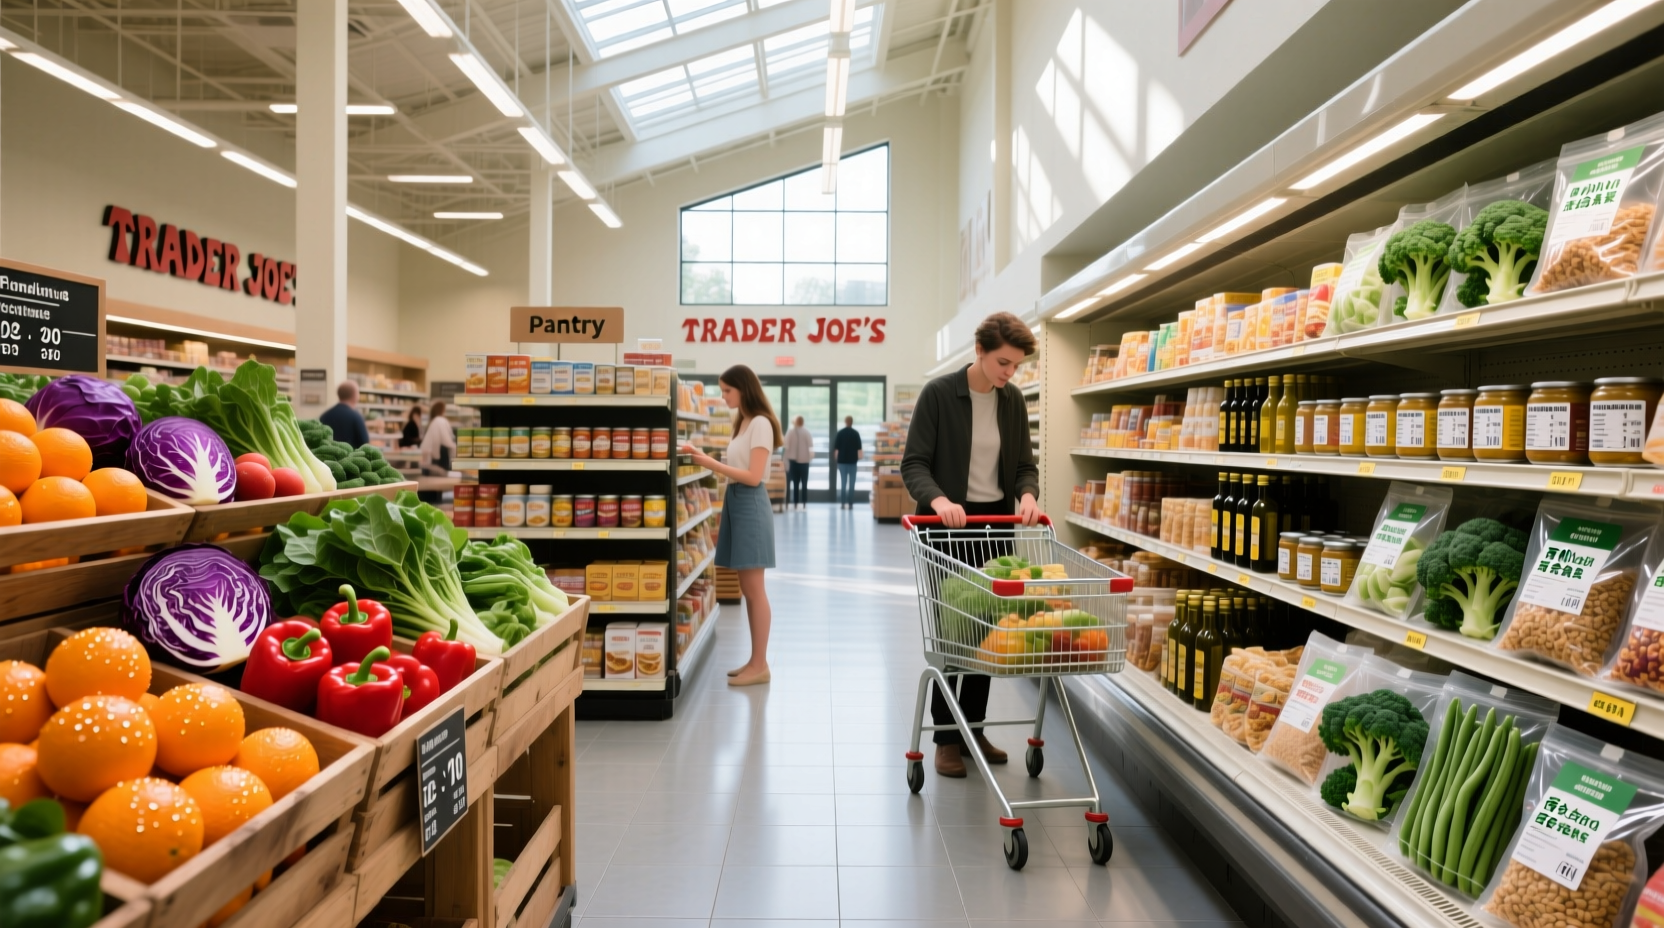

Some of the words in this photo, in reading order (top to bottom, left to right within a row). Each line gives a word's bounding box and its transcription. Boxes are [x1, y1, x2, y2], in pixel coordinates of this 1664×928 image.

[102, 205, 240, 292] TRADER
[529, 315, 605, 339] Pantry
[682, 318, 796, 343] TRADER
[807, 317, 886, 343] JOE'S
